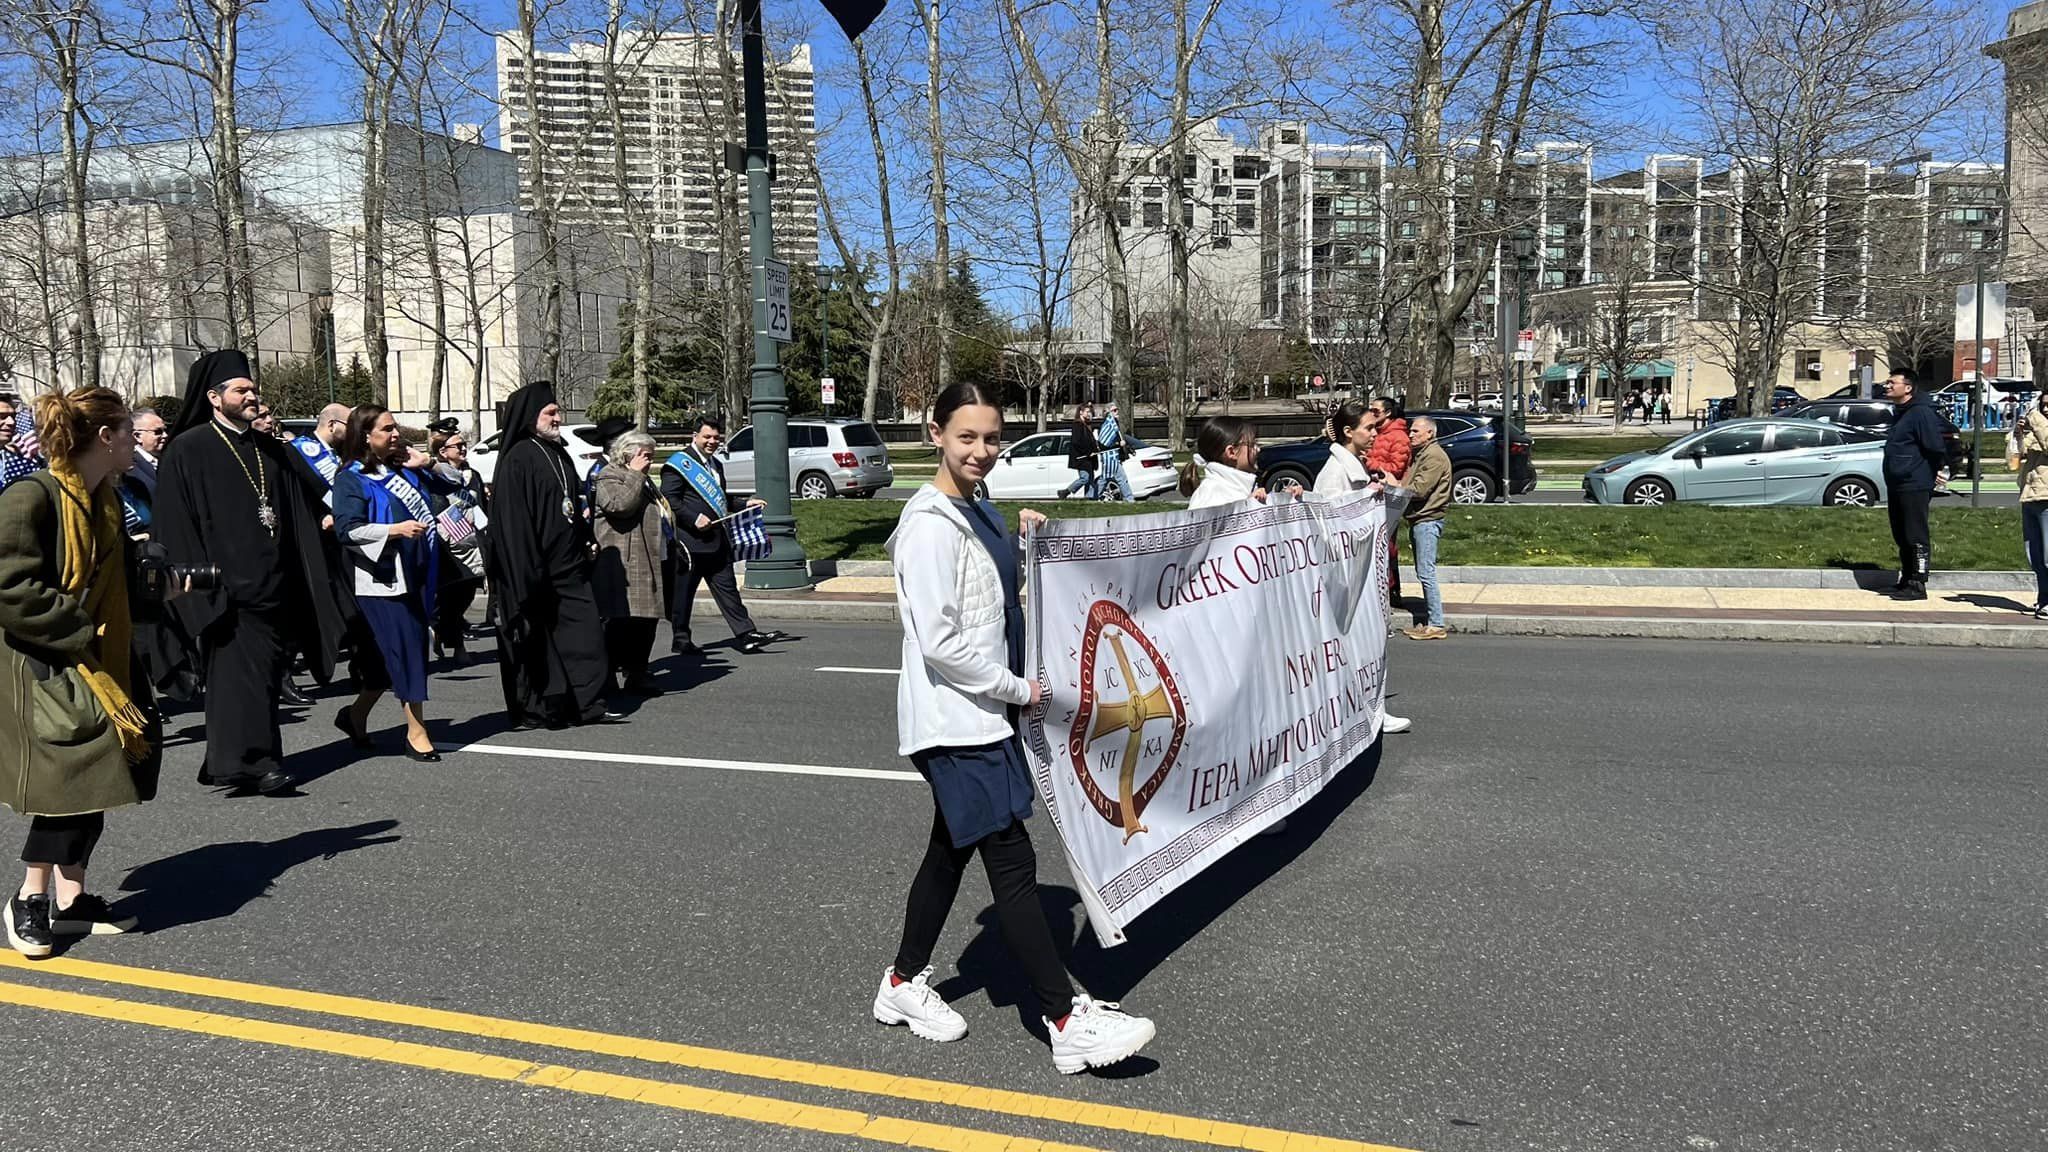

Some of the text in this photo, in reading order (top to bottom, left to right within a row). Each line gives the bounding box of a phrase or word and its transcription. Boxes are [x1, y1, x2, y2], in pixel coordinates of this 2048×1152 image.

[767, 267, 787, 284] SPEED
[769, 285, 785, 299] LIMIT
[770, 302, 788, 332] 25
[1156, 556, 1240, 611] GREEK
